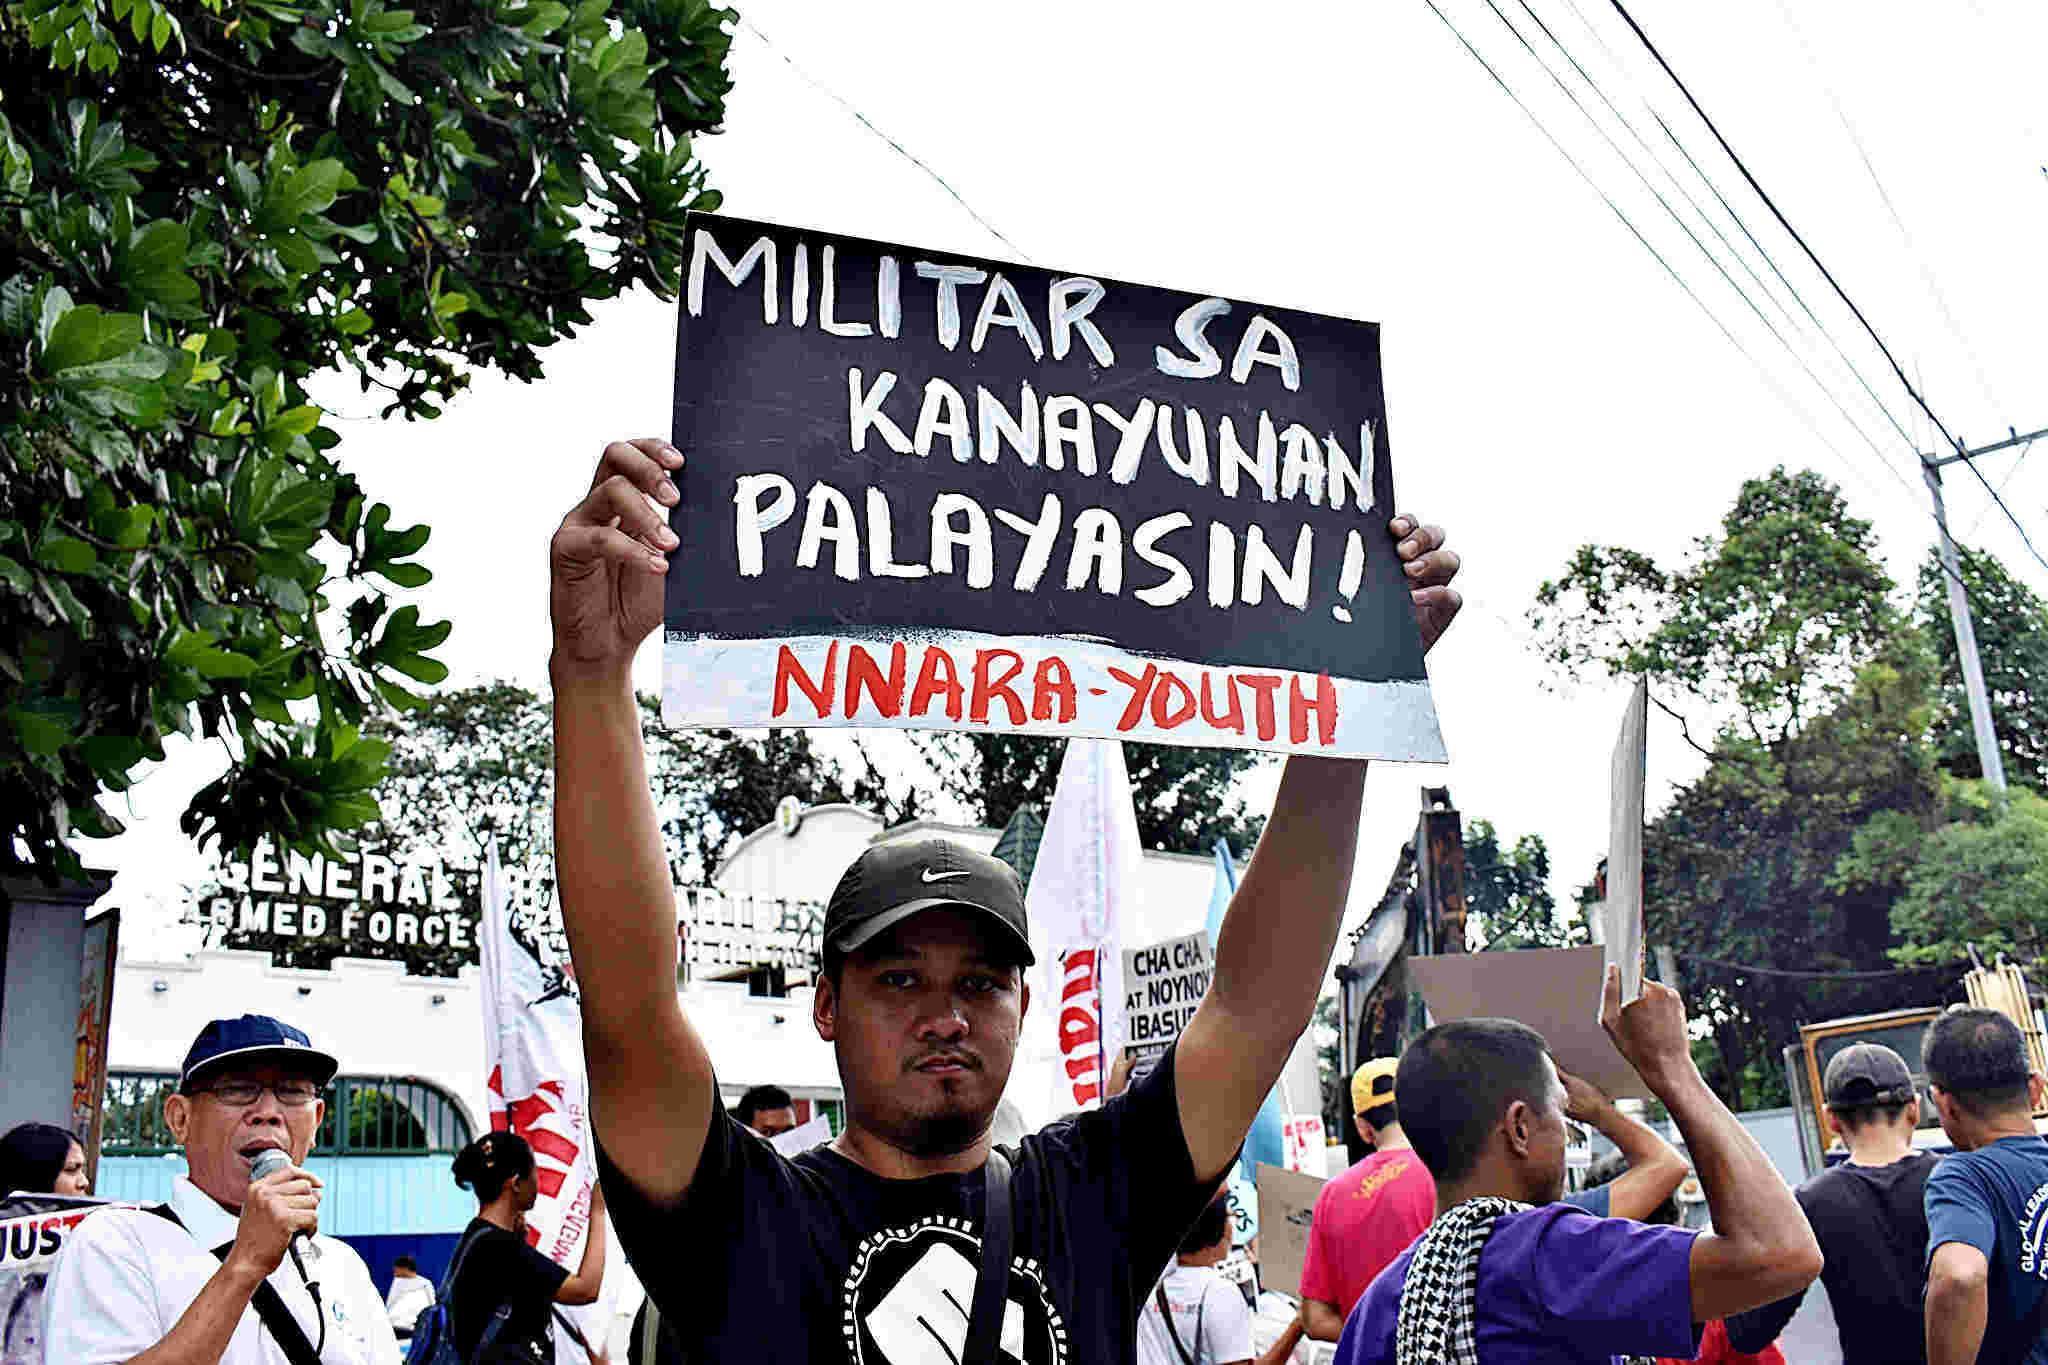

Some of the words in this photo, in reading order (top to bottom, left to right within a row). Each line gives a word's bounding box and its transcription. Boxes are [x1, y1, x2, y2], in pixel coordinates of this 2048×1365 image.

[688, 228, 1114, 368] MILITAR
[1156, 298, 1301, 391] SA
[848, 367, 1377, 513] KANAYUNAN
[771, 640, 1337, 746] NNARA-YOUTH
[184, 895, 327, 937] RMED
[1133, 946, 1171, 977] CHA
[1173, 938, 1204, 969] CHA
[1126, 991, 1143, 1010] AT
